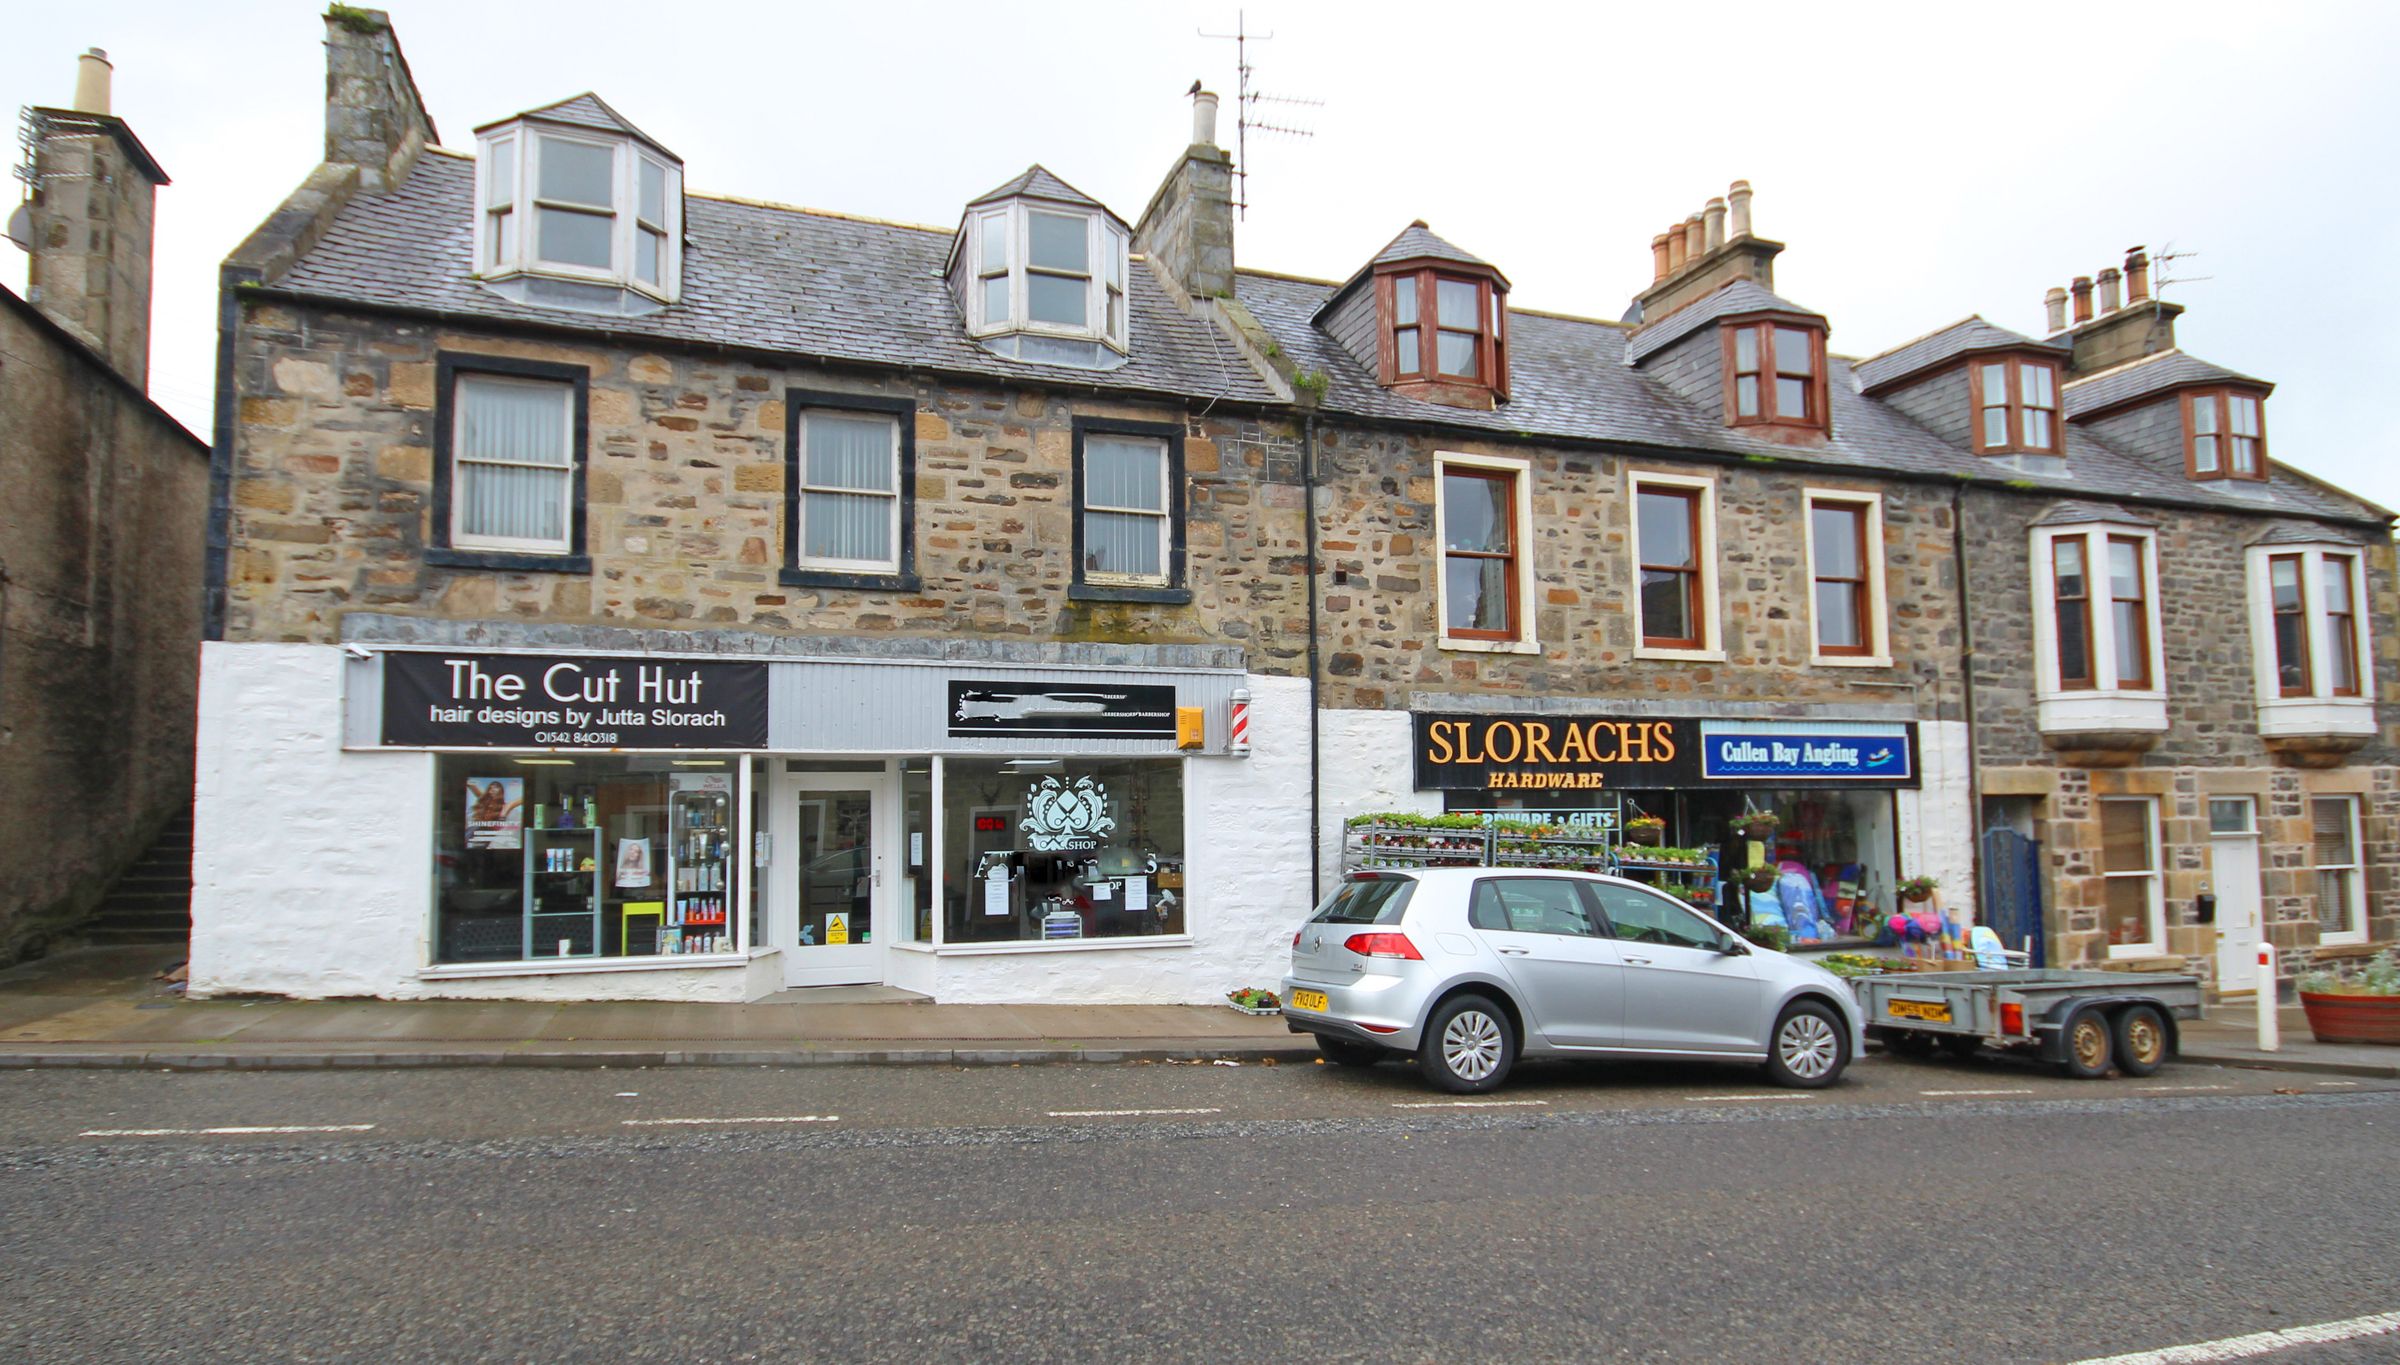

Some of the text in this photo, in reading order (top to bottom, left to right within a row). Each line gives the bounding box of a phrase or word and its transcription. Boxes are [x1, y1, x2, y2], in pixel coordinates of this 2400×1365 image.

[444, 659, 702, 704] The Cut Hut
[430, 704, 726, 729] hair designs by Jutta Slorach
[535, 731, 618, 744] 01542 840318
[1428, 720, 1676, 764] SLORACHS
[1721, 741, 1859, 767] Cullen Bay Angling
[1487, 771, 1604, 789] HARDWARE
[1569, 812, 1614, 828] GIFTS
